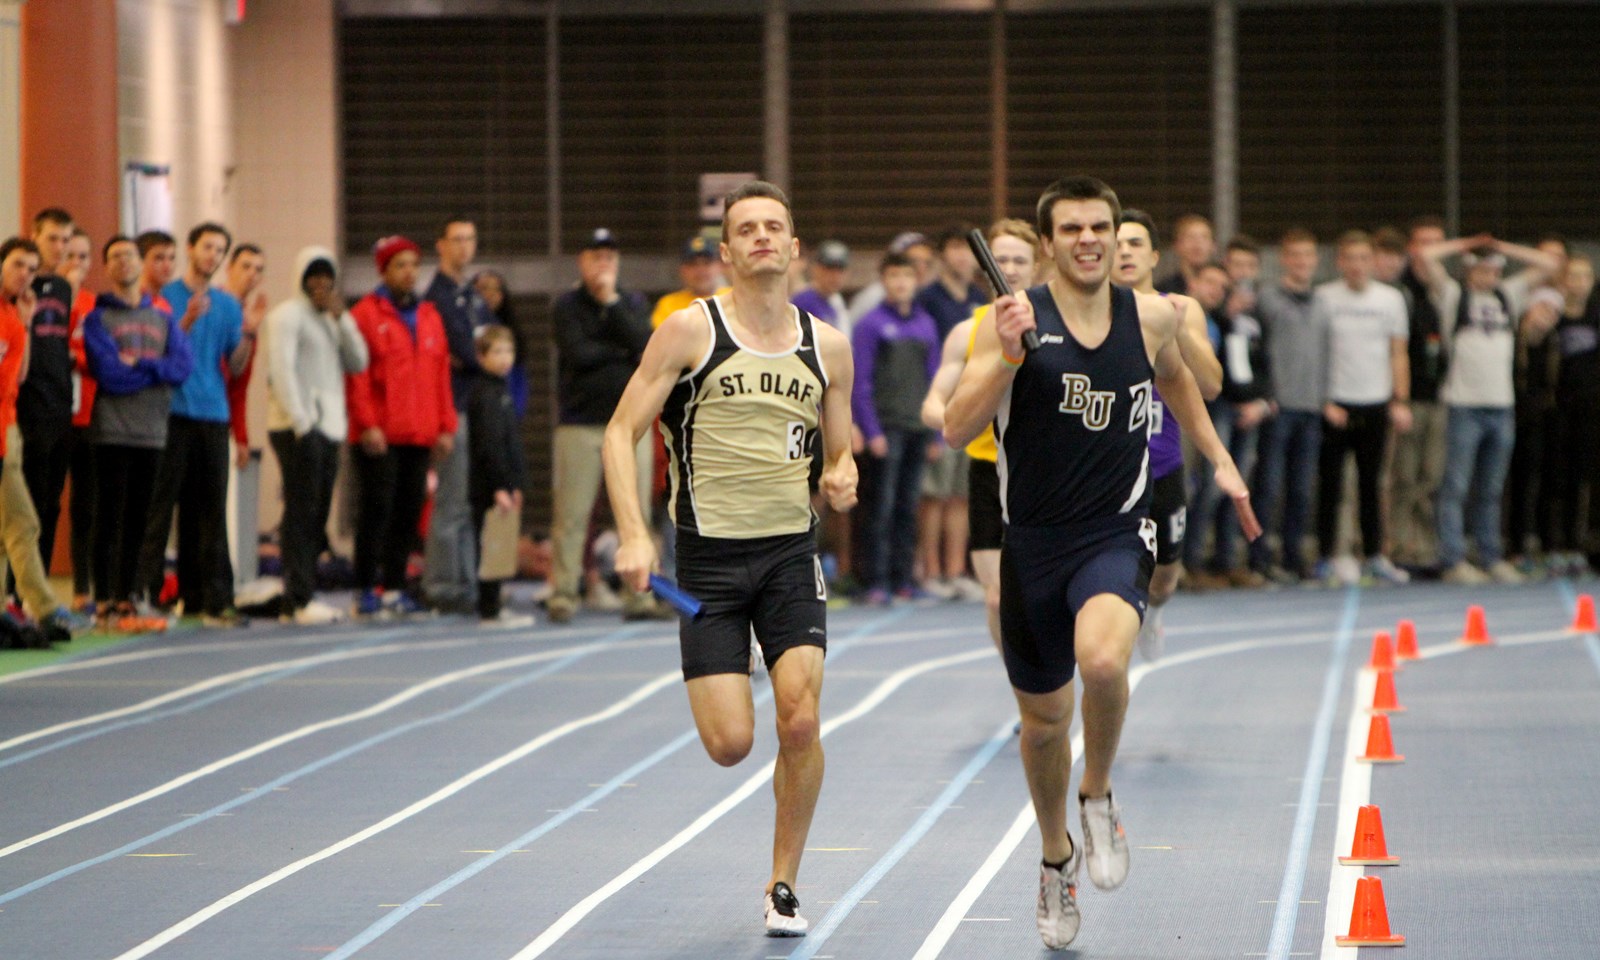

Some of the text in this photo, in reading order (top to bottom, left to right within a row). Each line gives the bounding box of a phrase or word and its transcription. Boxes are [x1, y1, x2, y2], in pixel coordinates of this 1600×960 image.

[719, 372, 814, 402] ST. OLAF
[1059, 373, 1116, 431] BU
[1133, 387, 1147, 426] 2
[789, 425, 804, 461] 3
